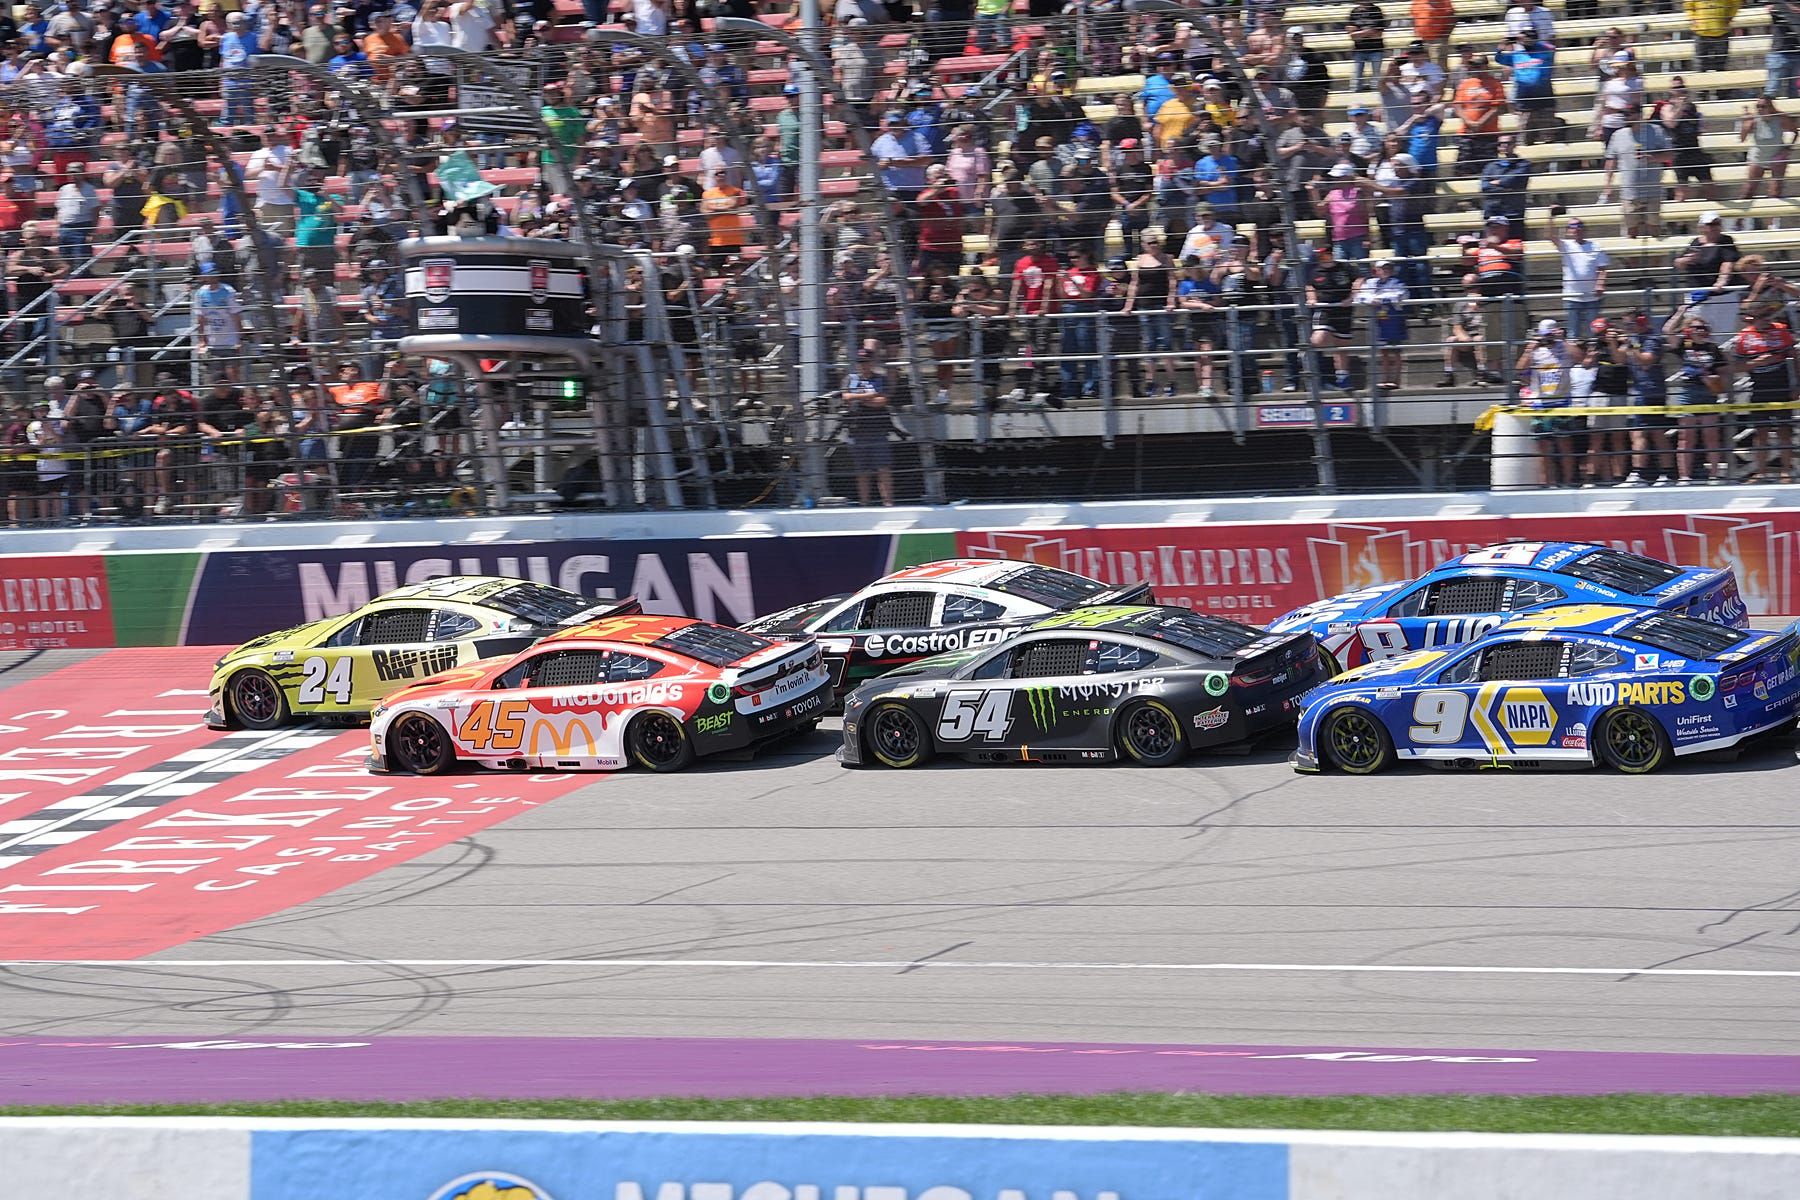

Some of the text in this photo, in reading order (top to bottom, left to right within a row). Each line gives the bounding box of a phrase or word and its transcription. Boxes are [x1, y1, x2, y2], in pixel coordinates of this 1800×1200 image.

[1330, 407, 1343, 420] 2
[1536, 550, 1573, 570] LUCAS
[0, 577, 102, 612] EEPERS
[1208, 595, 1276, 609] HOTEL
[27, 620, 88, 634] HOTEL
[886, 630, 964, 656] Castrol
[1357, 622, 1411, 664] 8
[299, 656, 353, 704] 24
[1059, 677, 1166, 701] MONSTER
[1767, 675, 1778, 690] GET
[551, 681, 684, 708] McDonald's
[792, 696, 821, 715] TOYOTA
[1567, 681, 1686, 706] AUTO PARTS
[459, 700, 531, 749] 45
[696, 711, 734, 734] BEAST
[937, 689, 1015, 742] 54
[1063, 707, 1117, 717] ENERGY
[1408, 691, 1470, 744] 9
[1506, 704, 1549, 729] NAPA
[1677, 714, 1712, 726] UniFirst
[329, 795, 520, 862] BATTLE
